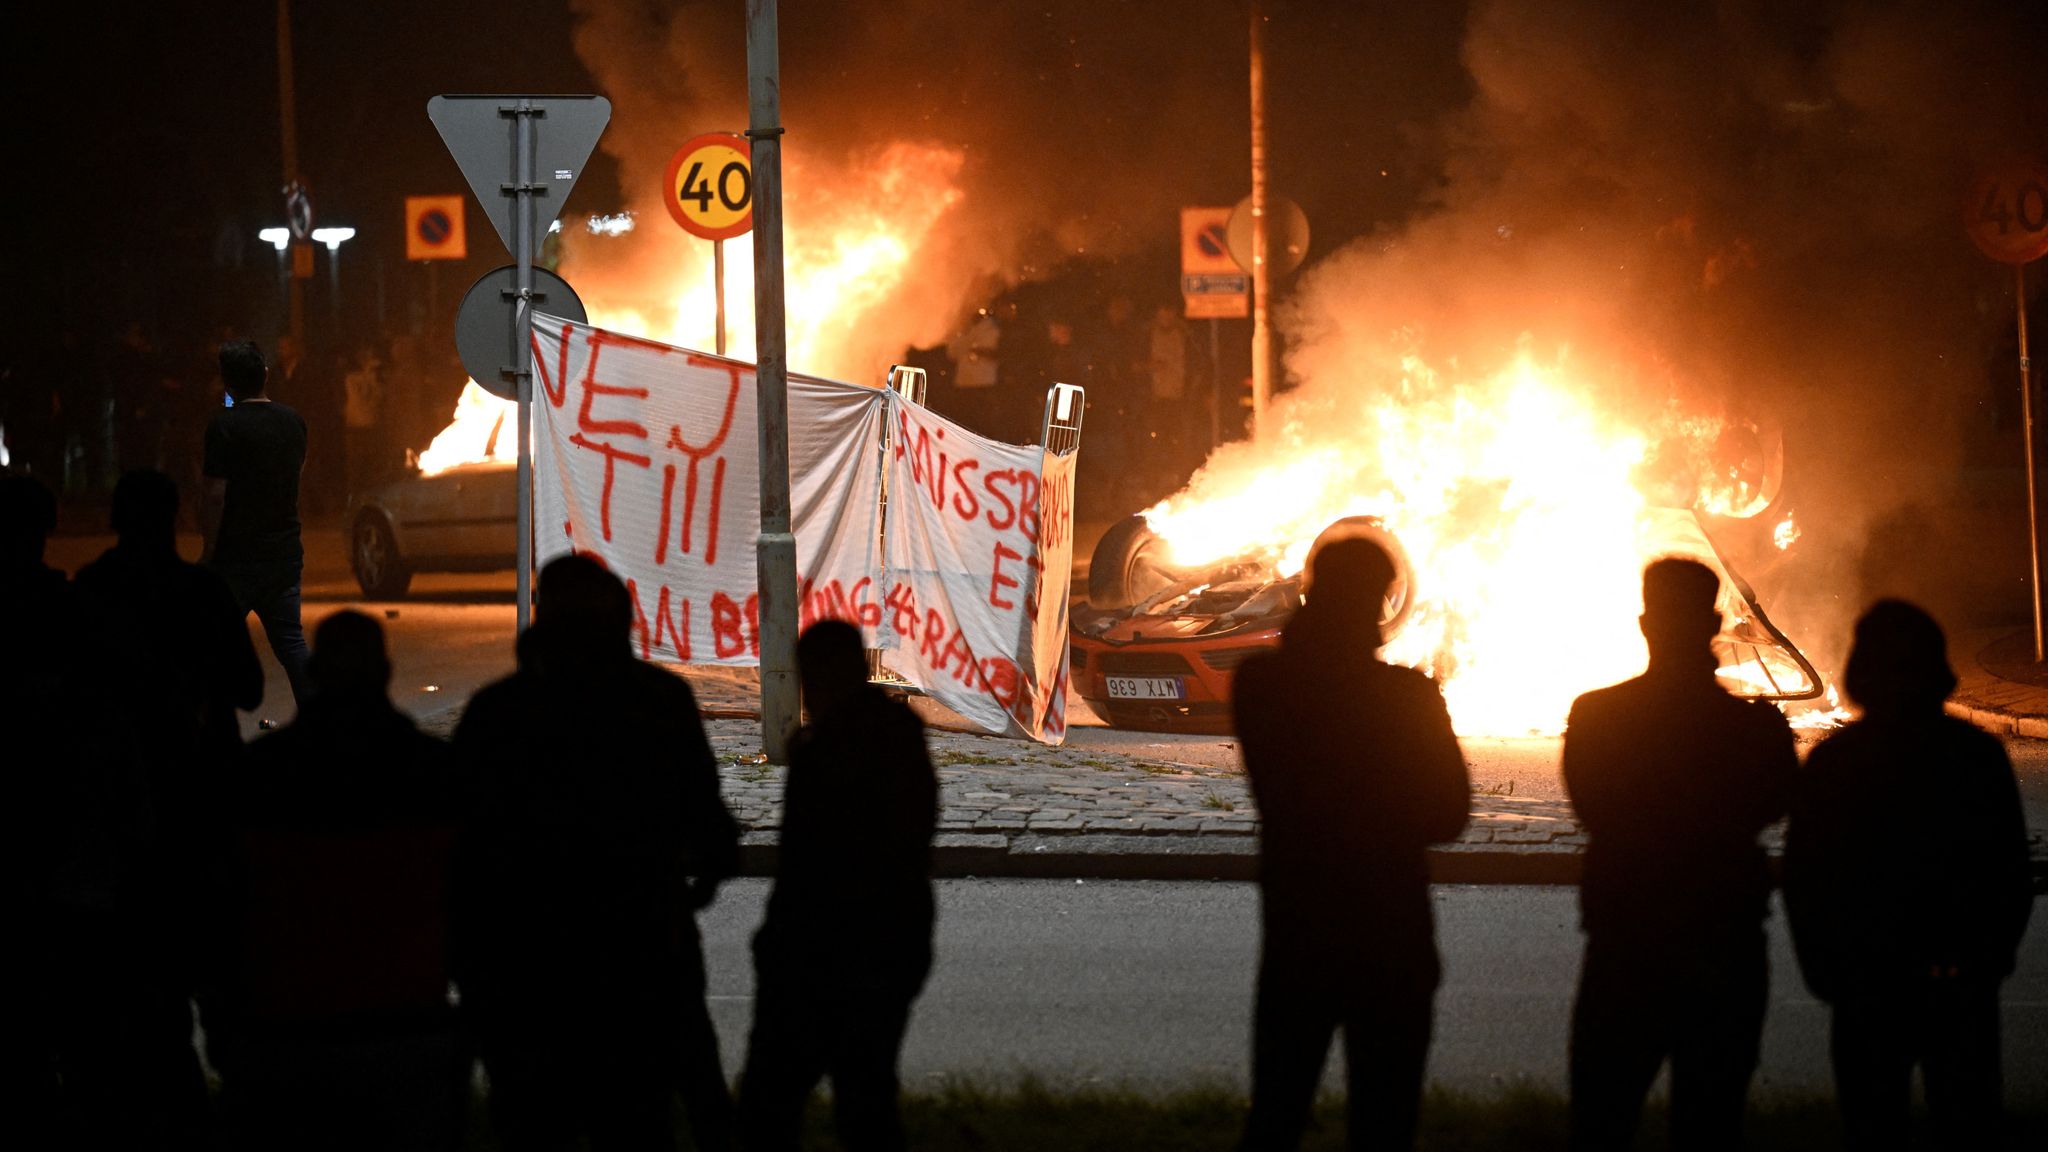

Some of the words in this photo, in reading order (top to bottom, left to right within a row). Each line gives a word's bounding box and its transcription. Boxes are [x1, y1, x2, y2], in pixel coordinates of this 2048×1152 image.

[680, 161, 752, 212] 40
[1980, 181, 2048, 233] 40
[1109, 679, 1137, 696] 636
[1145, 680, 1176, 697] WTX
